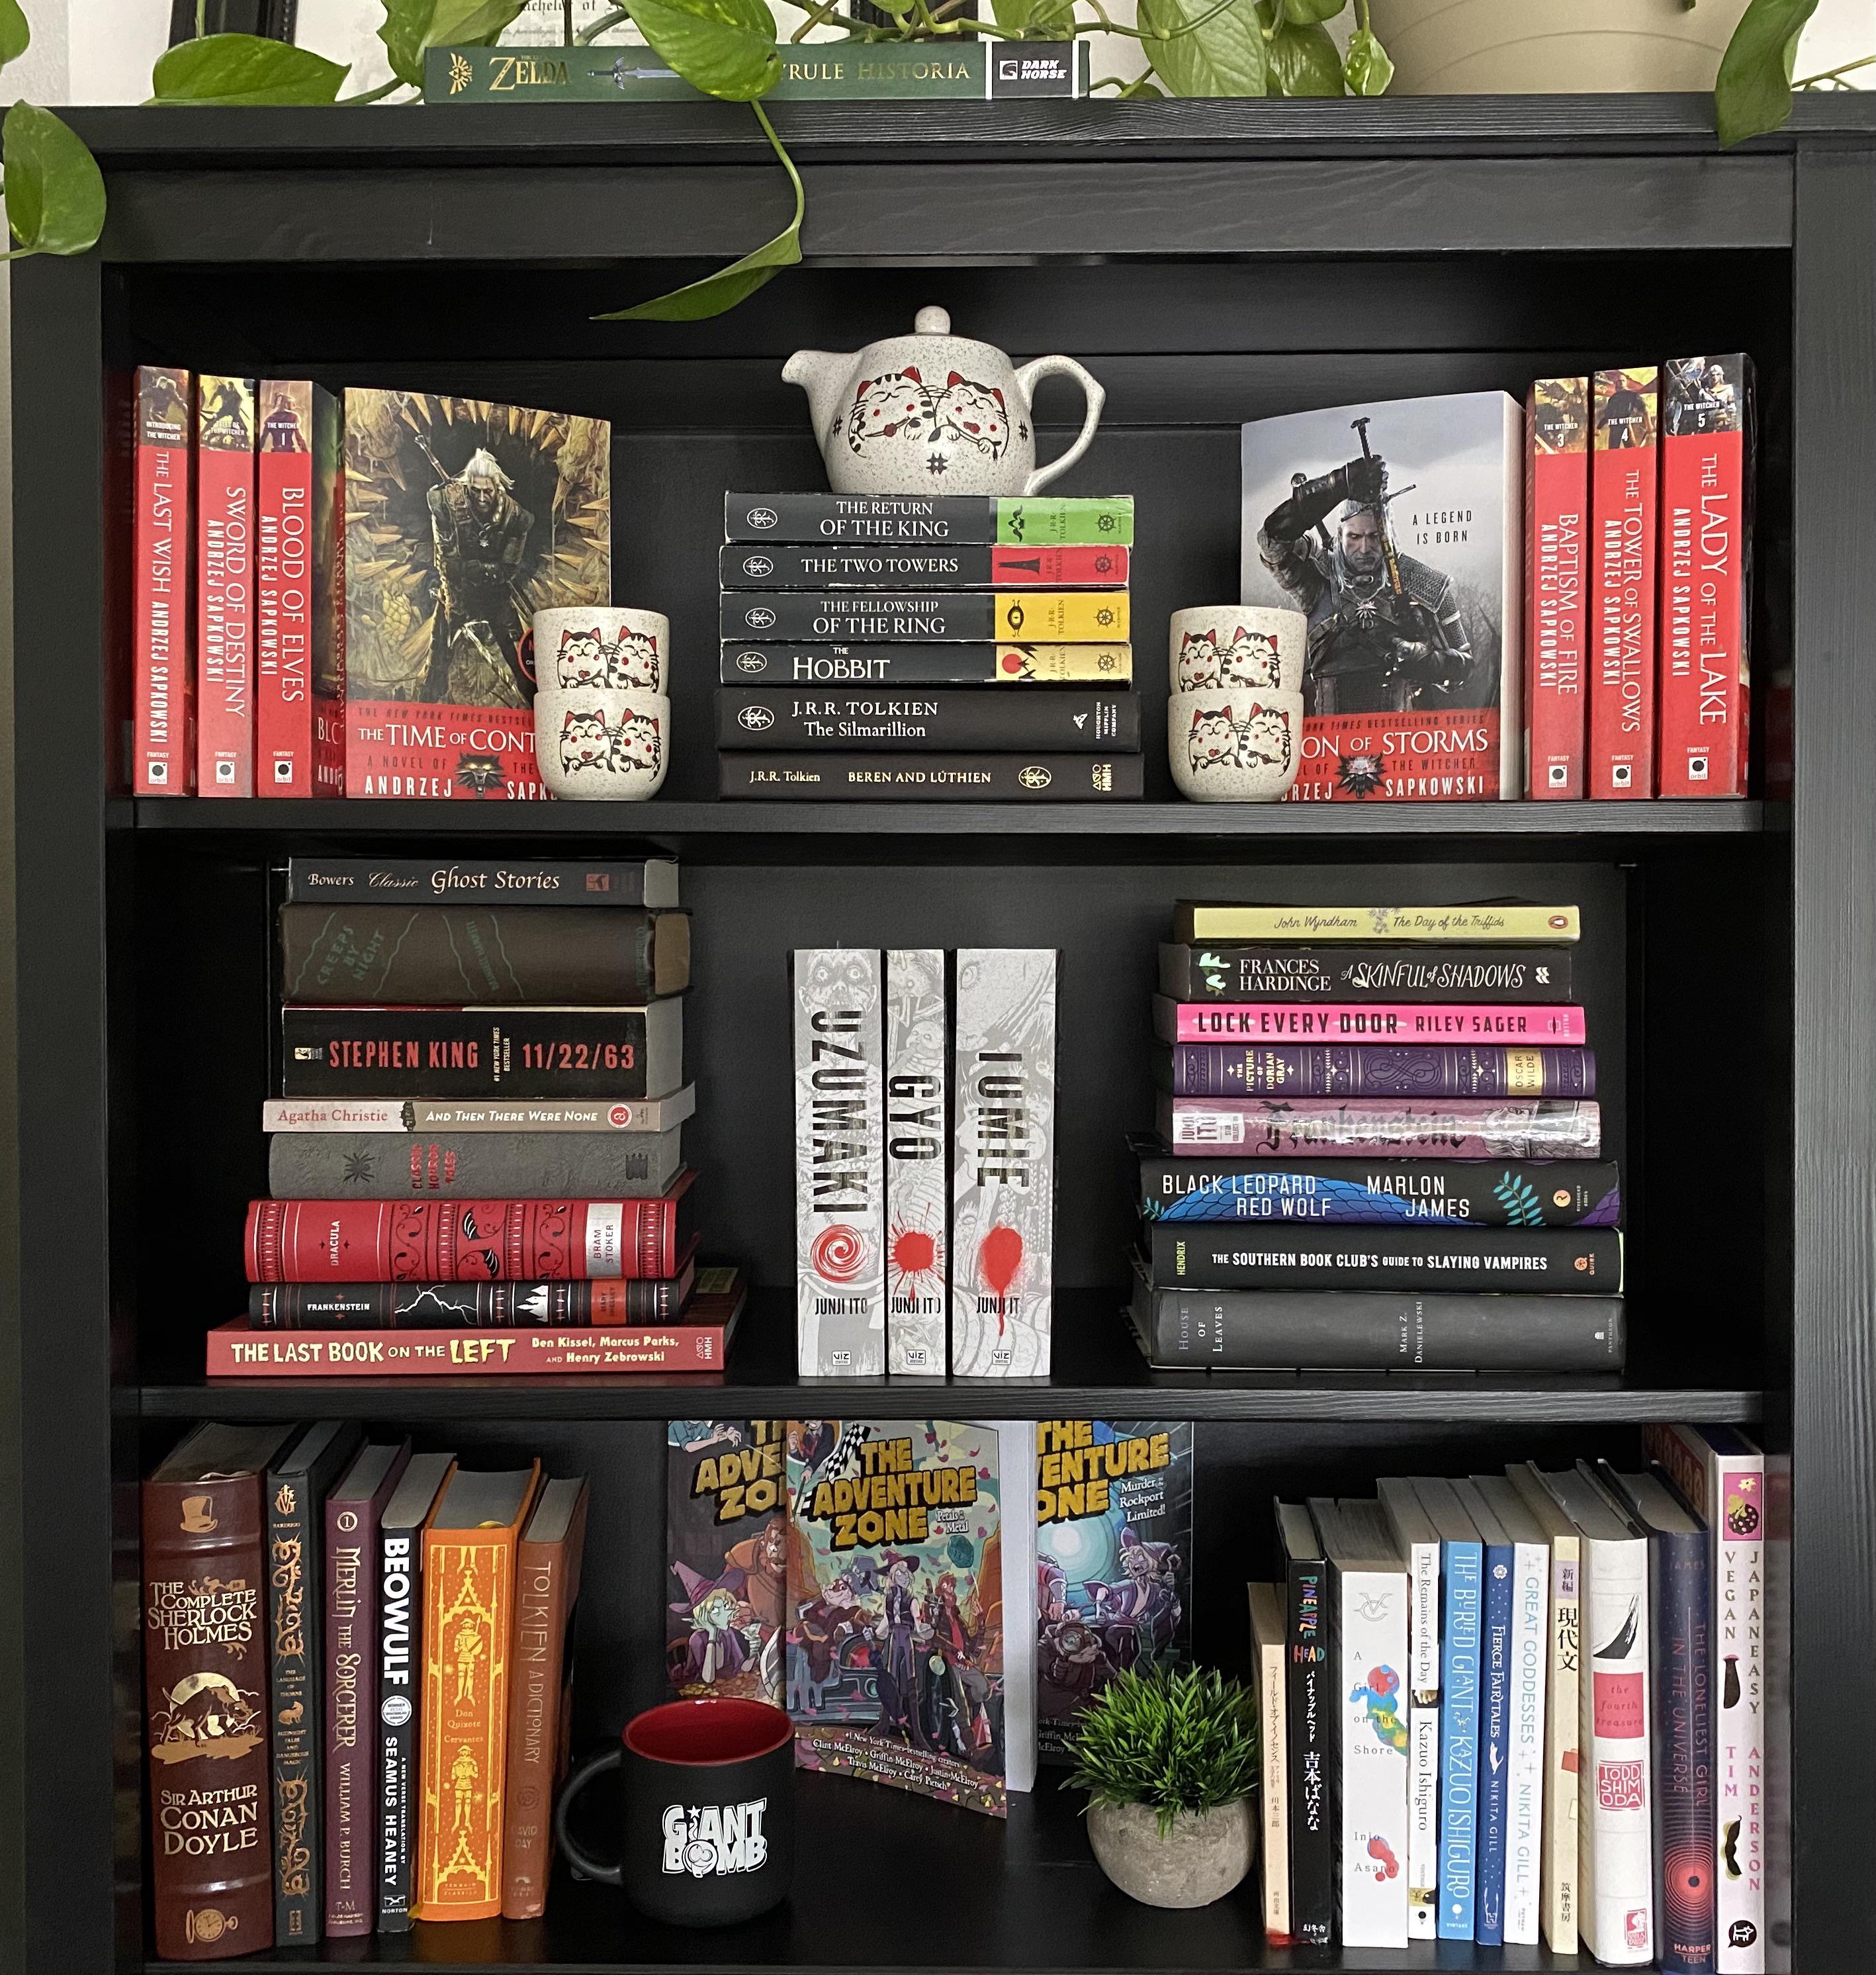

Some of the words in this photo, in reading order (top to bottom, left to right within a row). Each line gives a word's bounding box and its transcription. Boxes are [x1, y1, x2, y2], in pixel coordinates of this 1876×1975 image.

[489, 57, 571, 91] ZELDA
[1020, 69, 1067, 79] HORSE
[1021, 60, 1059, 69] DARK
[156, 451, 169, 477] THE
[1701, 453, 1717, 488] THE
[1626, 469, 1640, 499] THE
[153, 484, 173, 531] LAST
[836, 501, 868, 514] THE
[871, 502, 933, 515] RETURN
[1413, 514, 1417, 526] A
[1426, 510, 1472, 524] LEGEND
[226, 487, 246, 574] SWORD
[282, 487, 304, 578] BLOOD
[820, 520, 846, 537] OF
[855, 520, 893, 536] THE
[896, 520, 949, 538] KING
[1417, 533, 1427, 545] IS
[1437, 530, 1467, 543] BORN
[1624, 502, 1642, 584] TOWER
[1701, 494, 1728, 576] LADY
[152, 537, 171, 592] WISH
[207, 520, 224, 587] ANDRZEJ
[801, 559, 836, 573] THE
[840, 559, 885, 573] TWO
[889, 558, 959, 573] TOWERS
[1541, 524, 1558, 590] ANDRZEJ
[1559, 514, 1578, 611] BAPTISM
[1605, 520, 1621, 588] ANDRZEJ
[226, 583, 245, 614] OF
[282, 590, 304, 623] OF
[821, 601, 854, 613] THE
[856, 600, 939, 614] FELLOWSHIP
[1624, 588, 1638, 608] OF
[1701, 582, 1716, 606] OF
[151, 602, 169, 661] ANDRZEJ
[206, 596, 224, 682] SAPKOWSKI
[813, 618, 842, 634] OF
[844, 618, 889, 634] THE
[894, 618, 946, 634] RING
[1560, 619, 1574, 641] OF
[1603, 596, 1621, 685] SAPKOWSKI
[1701, 614, 1716, 646] THE
[832, 647, 849, 655] THE
[1540, 600, 1557, 687] SAPKOWSKI
[225, 622, 245, 718] DESTINY
[282, 634, 304, 702] ELVES
[793, 659, 891, 680] HOBBIT
[1558, 649, 1578, 695] FIRE
[1621, 613, 1641, 732] SWALLOWS
[1699, 651, 1727, 725] LAKE
[150, 666, 168, 743] SAPKOWSKI
[792, 702, 841, 717] J.R.R.
[846, 702, 938, 716] TOLKIEN
[804, 721, 834, 737] The
[838, 721, 926, 737] Silmarillion
[1350, 737, 1372, 751] OF
[1382, 729, 1488, 755] STORMS
[365, 776, 452, 798] ANDRZEJ
[750, 771, 780, 782] J.R.R.
[783, 770, 821, 782] Tolkien
[308, 874, 355, 887] Bowers
[368, 872, 418, 888] Classic
[431, 866, 488, 895] Ghost
[495, 871, 560, 890] Stories
[1274, 916, 1300, 929] John
[1304, 915, 1358, 931] Wyndham
[1393, 917, 1411, 928] The
[1414, 916, 1436, 931] Day
[1438, 915, 1451, 931] of
[1452, 916, 1468, 928] the
[1470, 915, 1505, 931] Triffids
[1239, 959, 1319, 975] FRANCES
[1341, 965, 1354, 980] A
[1352, 960, 1428, 989] SKINFUL
[1426, 962, 1437, 984] of
[1438, 964, 1526, 988] SHADOWS
[1239, 975, 1331, 991] HARDINGE
[1198, 1012, 1251, 1033] LOCK
[1261, 1013, 1329, 1033] EVERY
[1340, 1013, 1398, 1034] DOOR
[1415, 1015, 1464, 1033] RILEY
[1472, 1017, 1527, 1033] SAGER
[330, 1041, 419, 1068] STEPHEN
[429, 1041, 478, 1068] KING
[523, 1043, 635, 1070] 11/22/63
[277, 1109, 329, 1124] Agatha
[332, 1109, 388, 1122] Christie
[811, 1011, 868, 1213] UZUMAKI
[889, 1075, 942, 1160] GYO
[1163, 1175, 1224, 1195] BLACK
[1231, 1175, 1316, 1195] LEOPARD
[1366, 1175, 1445, 1196] MARLON
[1236, 1198, 1273, 1218] RED
[1280, 1198, 1331, 1218] WOLF
[1406, 1199, 1470, 1218] JAMES
[329, 1220, 341, 1267] DRACULA
[1177, 1242, 1186, 1275] HENDRIX
[1212, 1254, 1229, 1263] THE
[1233, 1253, 1296, 1266] SOUTHERN
[1300, 1254, 1332, 1267] BOOK
[1336, 1254, 1378, 1268] CLUB'S
[1382, 1257, 1409, 1267] GUIDE
[1412, 1258, 1423, 1267] TO
[1427, 1256, 1480, 1269] SLAYING
[1484, 1257, 1547, 1270] VAMPIRES
[306, 1303, 370, 1313] FRANKENSTEIN
[815, 1298, 847, 1315] JUNJI
[849, 1298, 868, 1314] ITO
[891, 1297, 919, 1314] JUNJI
[923, 1297, 941, 1314] ITO
[231, 1344, 269, 1363] THE
[273, 1343, 322, 1363] LAST
[328, 1342, 384, 1362] BOOK
[388, 1346, 410, 1357] ON
[414, 1346, 445, 1357] THE
[449, 1340, 515, 1363] LEFT
[566, 1352, 600, 1365] Henry
[605, 1352, 664, 1362] Zebrowski
[860, 1438, 914, 1476] THE
[813, 1467, 977, 1516] ADVENTURE
[1120, 1492, 1164, 1508] Rockport
[1121, 1478, 1156, 1493] Murder
[834, 1506, 928, 1547] ZONE
[1421, 1553, 1431, 1576] The
[161, 1589, 257, 1610] COMPLETE
[1299, 1575, 1318, 1639] PINEAPPLE
[1421, 1579, 1431, 1626] Remains
[1525, 1577, 1539, 1634] GREAT
[1724, 1551, 1736, 1639] VEGAN
[148, 1601, 257, 1630] SHERLOCK
[383, 1538, 410, 1684] BEOWULF
[164, 1622, 253, 1650] HOLMES
[1421, 1627, 1430, 1640] of
[1557, 1607, 1578, 1672] 現代文
[1293, 1644, 1325, 1663] HEAD
[1420, 1641, 1431, 1659] the
[1417, 1662, 1431, 1683] Day
[1521, 1640, 1538, 1743] GODDESSES
[1306, 1671, 1316, 1743] パイナップルヘッド
[447, 1720, 481, 1729] Quixote
[1354, 1745, 1393, 1755] Shore
[1419, 1721, 1429, 1767] Kazuo
[385, 1737, 398, 1808] SEAMUS
[1450, 1735, 1472, 1804] KAZUO
[160, 1789, 187, 1806] SIR
[188, 1784, 257, 1806] ARTHUR
[1303, 1751, 1322, 1831] 吉本ばなな
[1415, 1772, 1432, 1831] Ishiguro
[160, 1801, 258, 1830] CONAN
[1517, 1783, 1531, 1840] NIKITA
[1749, 1747, 1760, 1892] ANDERSON
[163, 1827, 259, 1855] DOYLE
[384, 1815, 397, 1886] HEANEY
[1447, 1809, 1471, 1899] ISHIGURO
[1517, 1846, 1530, 1882] GILL
[1674, 1943, 1711, 1953] HARPER
